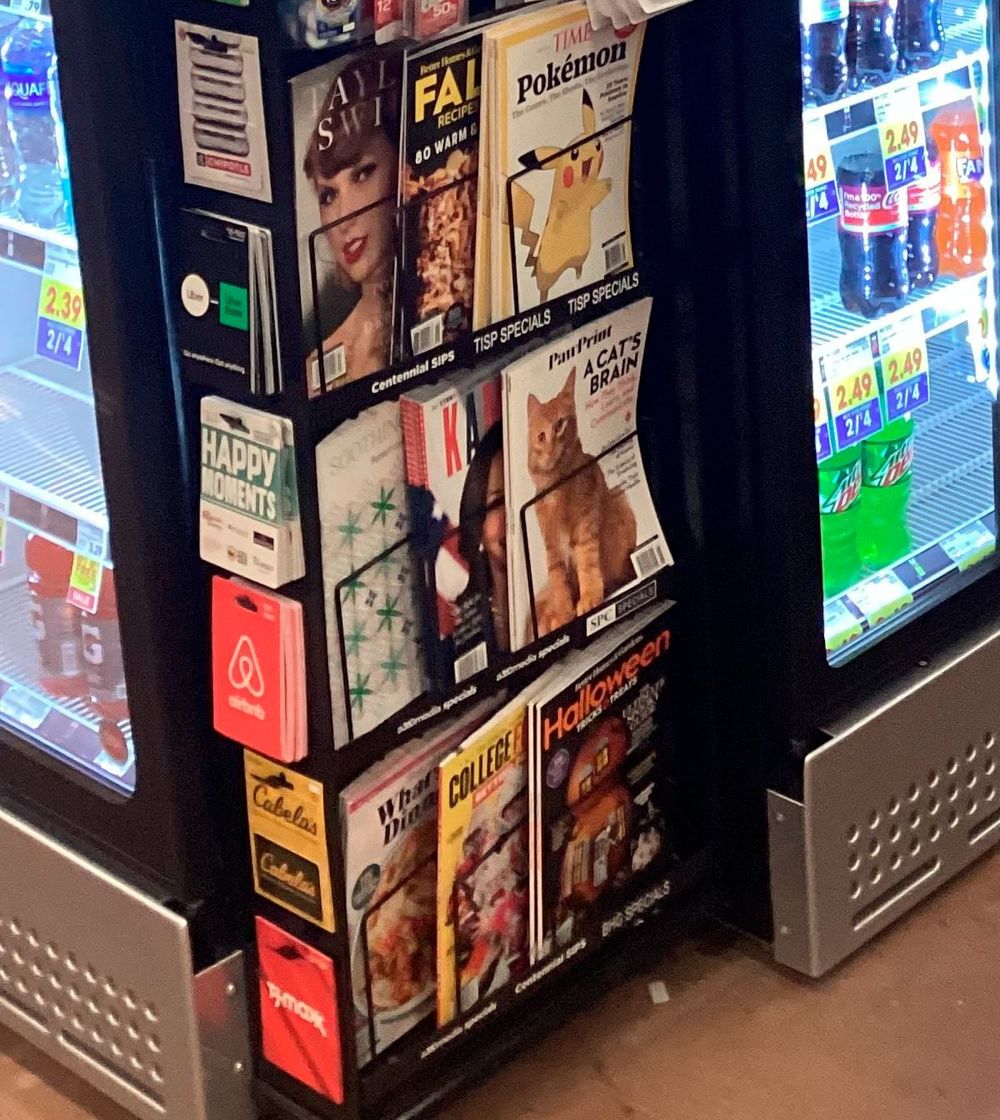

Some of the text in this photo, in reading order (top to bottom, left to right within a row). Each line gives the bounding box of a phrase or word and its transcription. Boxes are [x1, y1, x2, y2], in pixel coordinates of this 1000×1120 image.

[516, 41, 627, 105] Pokémon
[415, 126, 467, 165] 80 WARM
[885, 121, 918, 153] 2.49
[45, 286, 82, 323] 2.39
[186, 289, 204, 303] Uber
[567, 272, 640, 316] TISP SPECIALS
[474, 309, 552, 354] TISP SPECIALS
[549, 325, 612, 371] PawPrint
[371, 349, 456, 395] Centennial SIPS
[584, 331, 642, 379] A CAT'S
[590, 351, 639, 396] BRAIN
[836, 347, 922, 410] 2.49 2.49
[202, 428, 277, 487] HAPPY
[443, 400, 463, 479] K
[202, 467, 277, 520] MOMENTS
[590, 607, 614, 627] SPC
[538, 633, 571, 659] specials
[228, 692, 266, 721] airbnb
[443, 685, 478, 711] specials
[543, 629, 671, 750] Halloween
[610, 677, 638, 704] TREATS
[449, 729, 511, 809] COLLEGE
